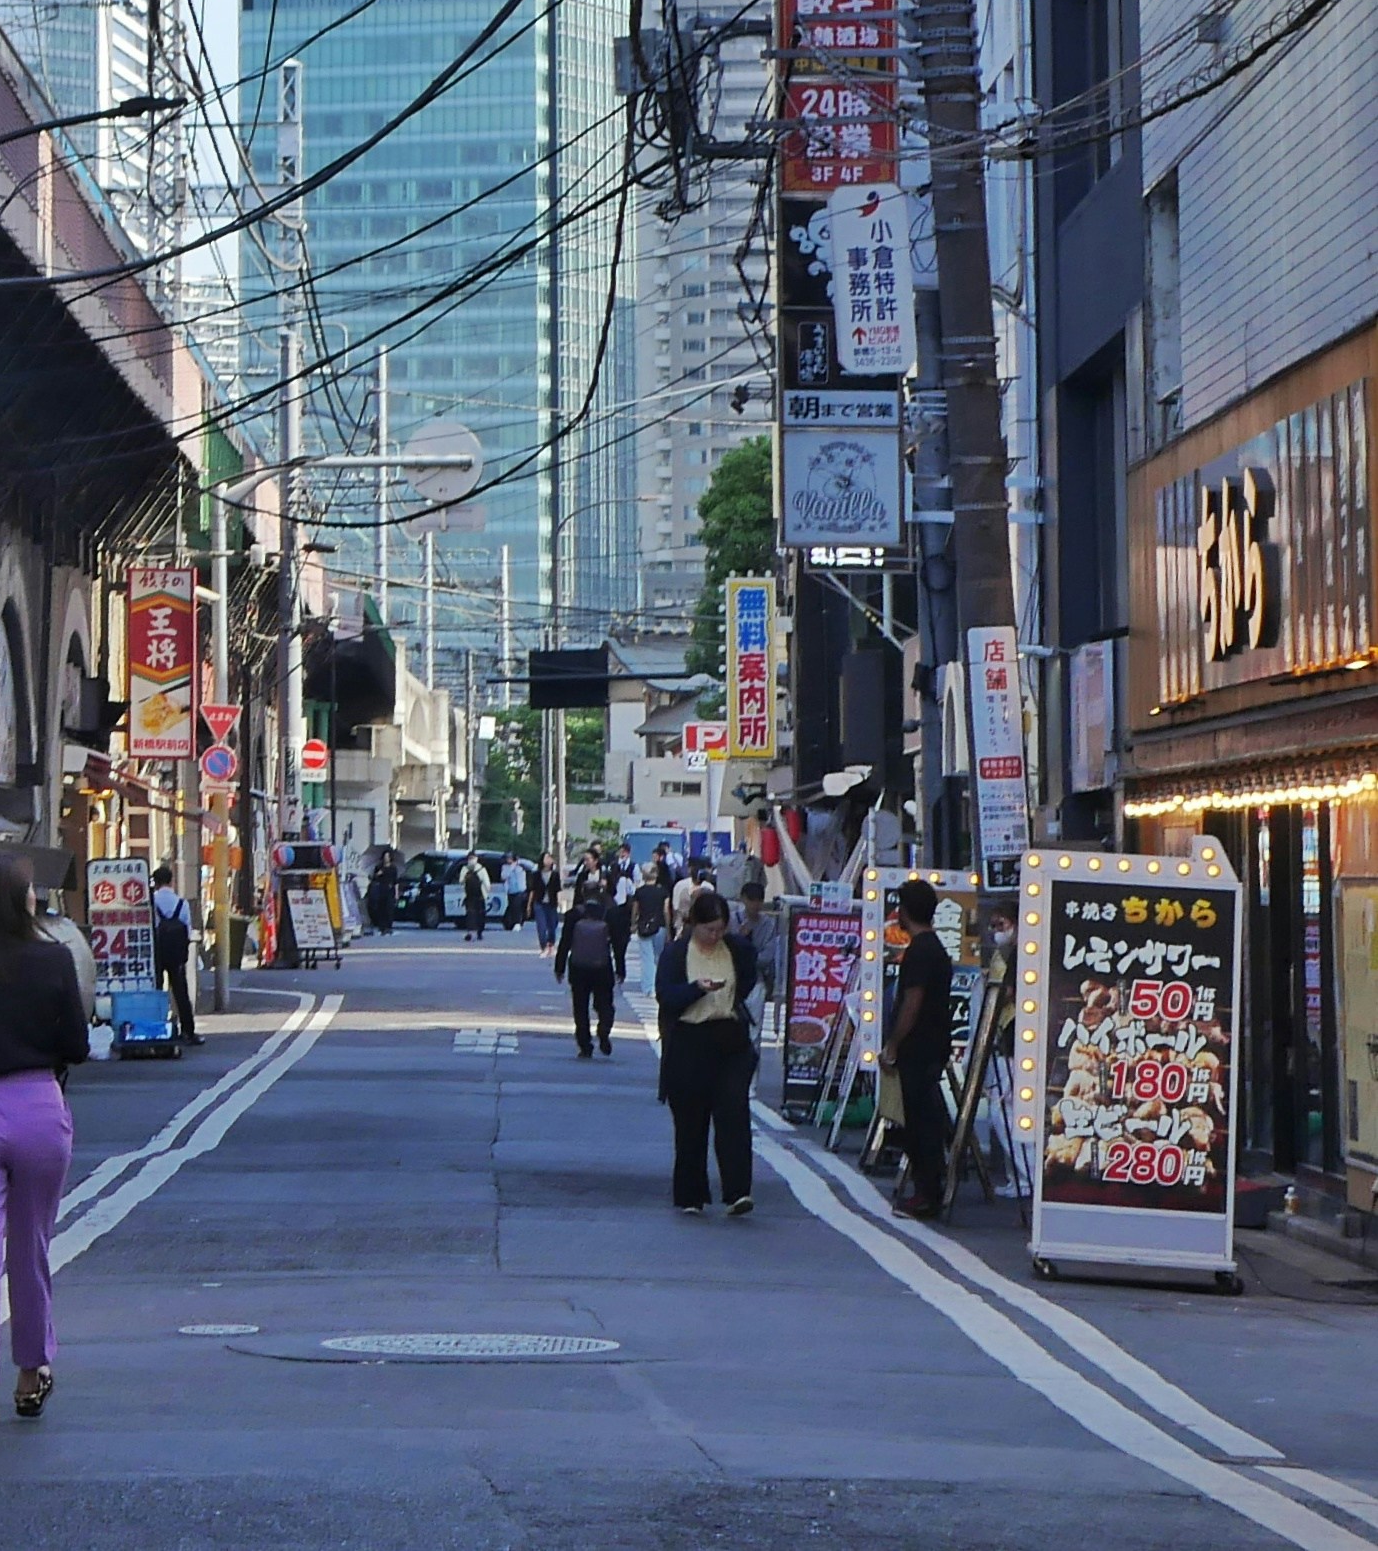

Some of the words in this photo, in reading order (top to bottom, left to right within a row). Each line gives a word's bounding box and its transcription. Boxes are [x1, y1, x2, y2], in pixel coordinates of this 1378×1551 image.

[811, 167, 834, 181] 3F
[841, 166, 863, 181] 4F
[848, 247, 872, 323] 事務所
[871, 218, 898, 322] 小倉特許
[789, 395, 893, 420] 朝まで営業
[793, 488, 887, 522] Vanilla
[1198, 466, 1263, 664] ちから
[146, 607, 178, 669] 王将
[737, 588, 768, 748] 無料案内所
[985, 640, 1008, 691] 店舗
[209, 711, 233, 722] 止まれ
[697, 727, 723, 749] P
[1065, 900, 1118, 922] 串焼き
[1121, 896, 1217, 928] ちから
[90, 929, 127, 960] 24
[1062, 934, 1221, 976] レモンサワー
[795, 950, 856, 982] 餃子
[1129, 979, 1192, 1022] 50
[1194, 1001, 1215, 1022] 円
[1057, 1017, 1207, 1059] ハイボール
[1109, 1061, 1188, 1102] 180
[1188, 1082, 1210, 1103] 円
[1058, 1100, 1192, 1142] 生ビール
[1102, 1142, 1185, 1186] 280
[1183, 1164, 1206, 1186] 円
